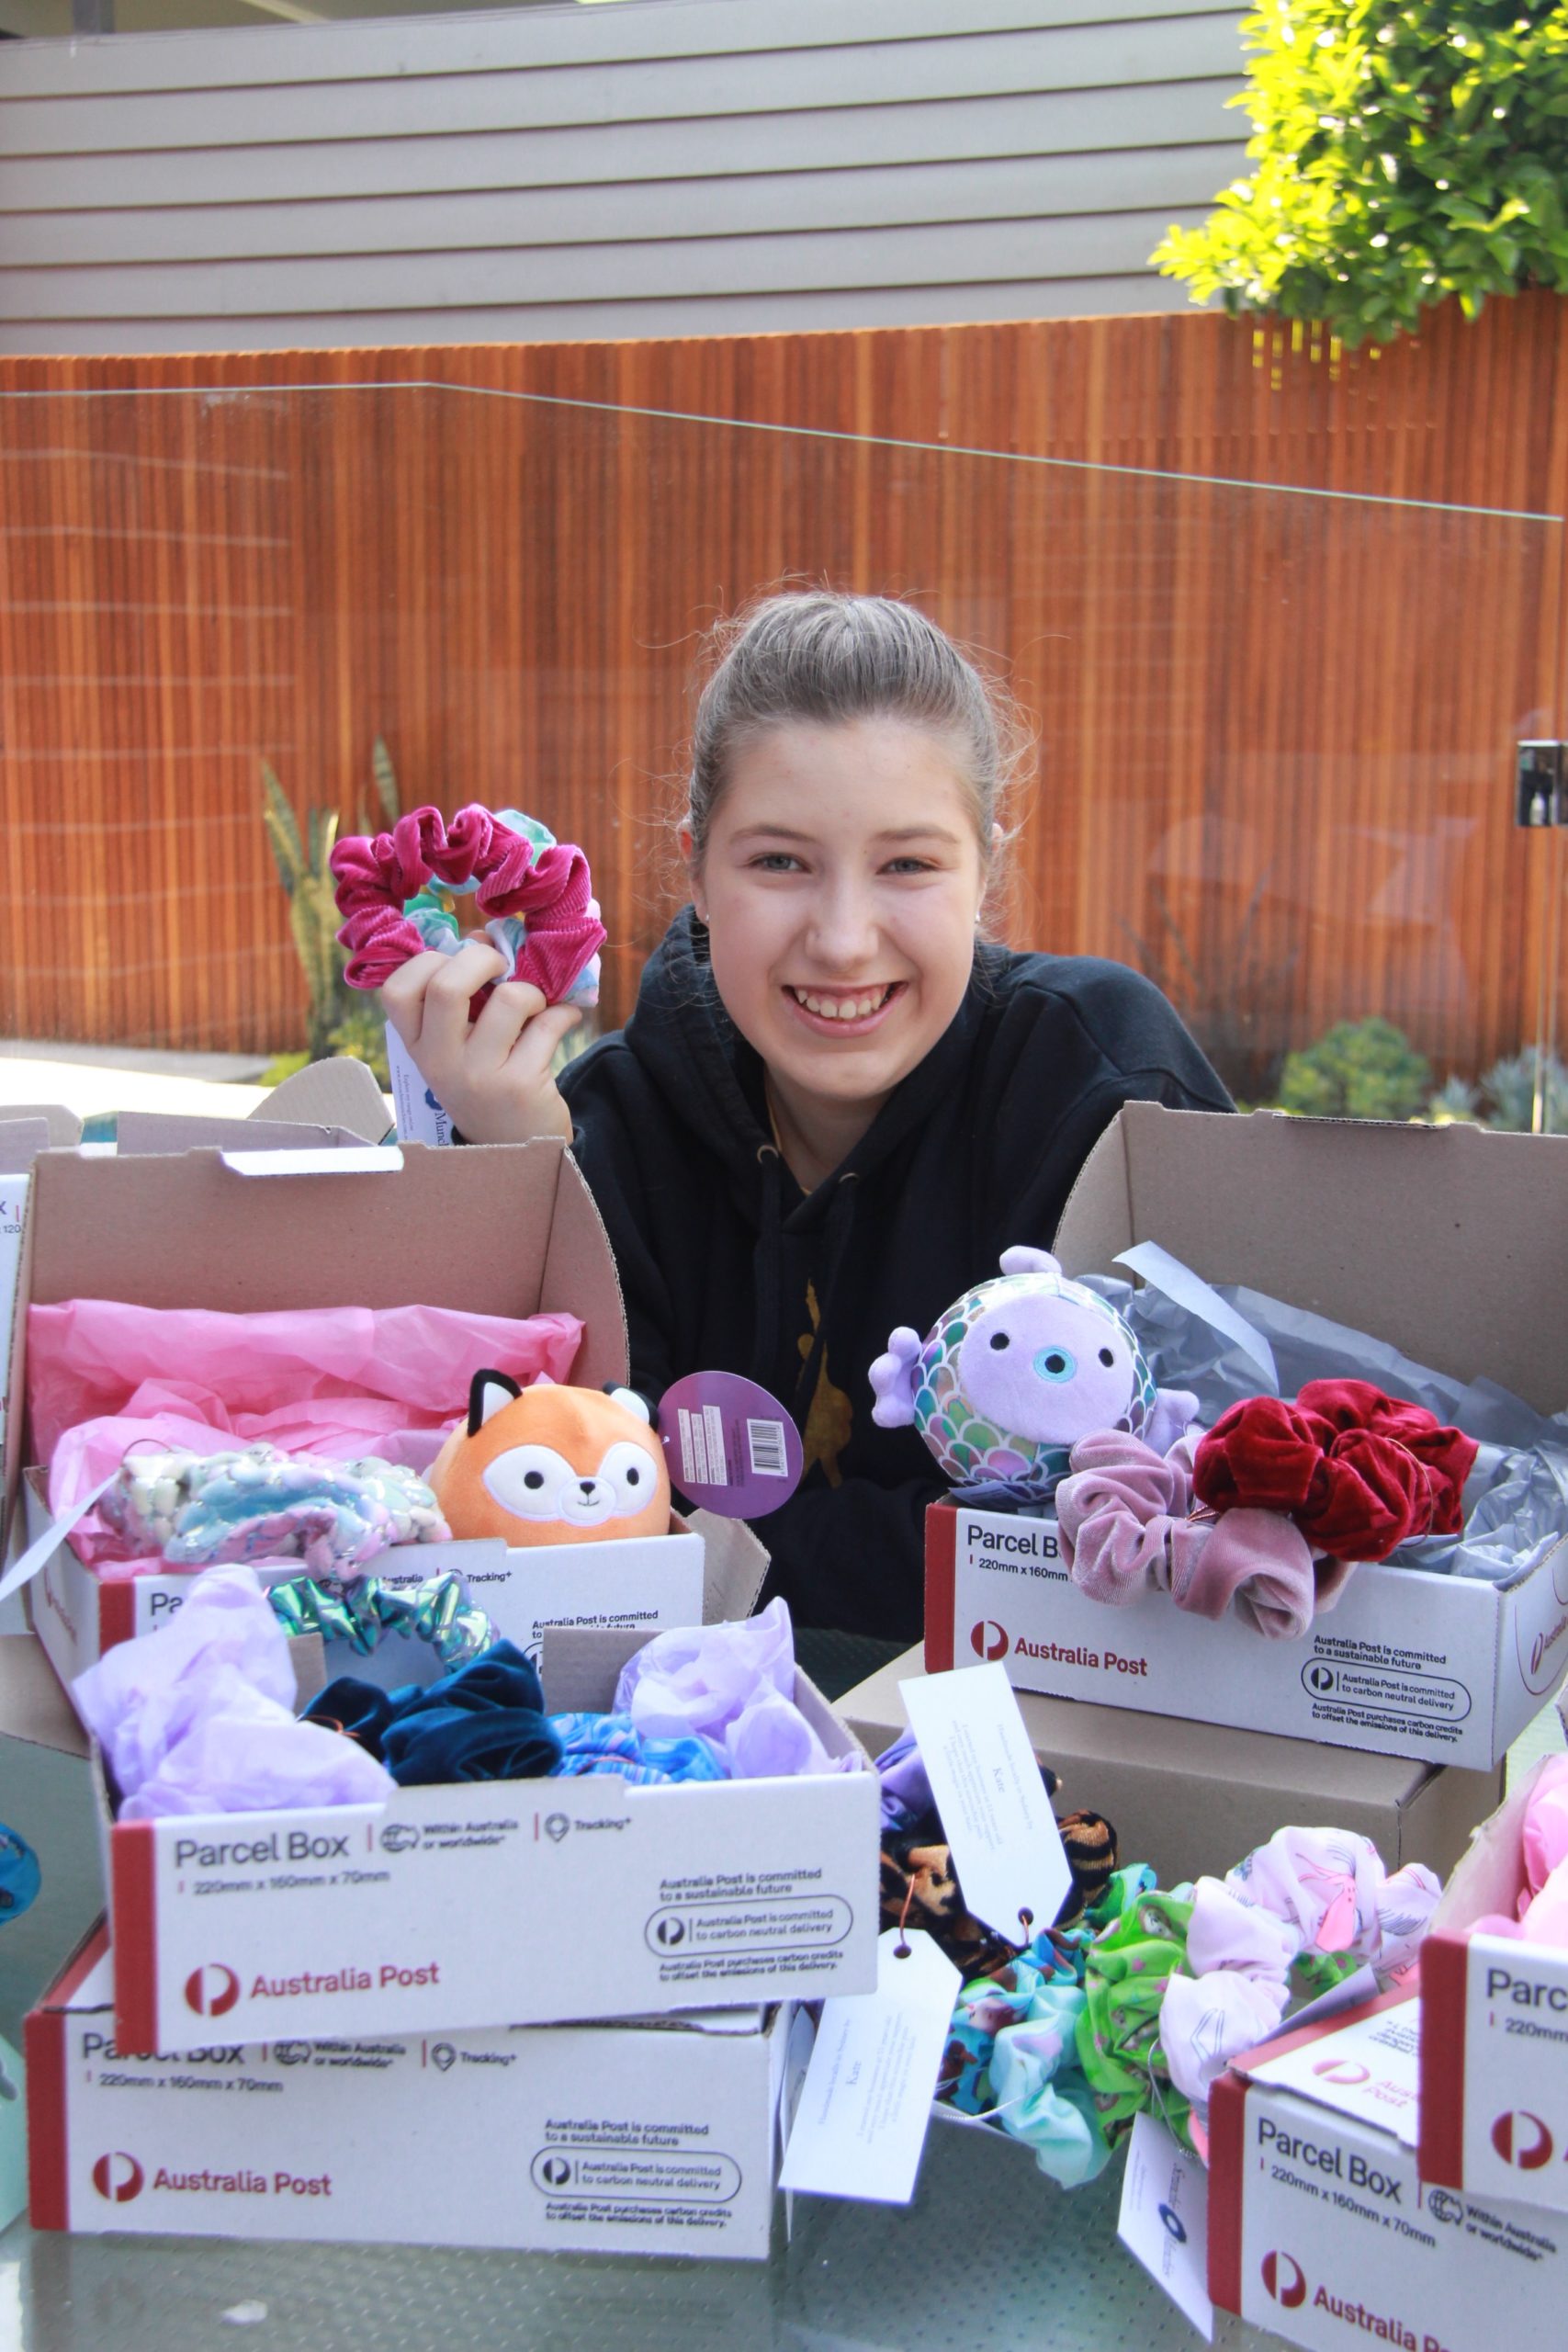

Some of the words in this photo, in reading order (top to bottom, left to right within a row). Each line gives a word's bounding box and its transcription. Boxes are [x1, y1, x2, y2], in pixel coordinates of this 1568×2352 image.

[968, 1524, 1038, 1555] Parcel
[979, 1558, 1018, 1573] 220mm
[1021, 1566, 1027, 1575] x
[1030, 1566, 1067, 1581] 160mm
[577, 1616, 597, 1625] Post
[599, 1614, 606, 1623] is
[608, 1611, 658, 1623] committed
[1014, 1637, 1099, 1668] Australia
[1104, 1652, 1147, 1676] Post
[1314, 1634, 1357, 1649] Australia
[1359, 1642, 1381, 1653] Post
[1383, 1645, 1391, 1655] is
[1393, 1647, 1446, 1665] committed
[1314, 1645, 1324, 1655] to
[1334, 1648, 1390, 1664] sustainable
[1392, 1657, 1421, 1669] future
[1342, 1674, 1379, 1687] Australia
[1381, 1679, 1400, 1690] Post
[1402, 1682, 1408, 1691] is
[1409, 1684, 1455, 1700] committed
[1342, 1684, 1351, 1692] to
[1353, 1685, 1382, 1698] carbon
[1385, 1690, 1416, 1703] neutral
[1418, 1696, 1453, 1711] delivery
[1312, 1711, 1320, 1719] to
[1322, 1713, 1345, 1723] offset
[1347, 1715, 1359, 1724] the
[1359, 1718, 1397, 1732] emissions
[1399, 1725, 1407, 1734] of
[1409, 1726, 1423, 1736] this
[1425, 1730, 1457, 1743] delivery.
[1313, 1702, 1346, 1715] Australia
[1348, 1709, 1365, 1719] Post
[1366, 1713, 1405, 1725] purchases
[1407, 1718, 1434, 1730] carbon
[1435, 1723, 1462, 1736] credits
[175, 1832, 279, 1869] Parcel
[288, 1831, 350, 1860] Box
[194, 1878, 253, 1895] 220mm
[256, 1879, 265, 1891] x
[270, 1874, 326, 1890] 160mm
[330, 1874, 337, 1884] x
[342, 1870, 390, 1883] 70mm
[660, 1875, 713, 1890] Australia
[716, 1872, 743, 1885] Post
[746, 1872, 755, 1883] is
[759, 1868, 822, 1883] committed
[660, 1890, 671, 1902] to
[685, 1884, 753, 1899] sustainable
[756, 1883, 792, 1894] future
[696, 1915, 742, 1928] Australia
[744, 1914, 767, 1925] Post
[769, 1913, 778, 1922] is
[779, 1910, 833, 1921] committed
[696, 1930, 707, 1940] to
[710, 1928, 747, 1939] carbon
[749, 1925, 787, 1937] neutral
[790, 1922, 832, 1935] delivery
[660, 1960, 702, 1973] Australia
[704, 1958, 725, 1968] Post
[728, 1955, 774, 1968] purchases
[777, 1952, 808, 1962] carbon
[810, 1950, 843, 1961] credits
[250, 1968, 371, 1999] Australia
[378, 1962, 439, 1988] Post
[1488, 1968, 1568, 2011] Parc
[99, 2073, 154, 2087] 220mm
[157, 2077, 166, 2087] x
[170, 2076, 222, 2090] 160mm
[226, 2079, 233, 2090] x
[238, 2077, 284, 2093] 70mm
[545, 2119, 598, 2131] Australia
[602, 2120, 628, 2132] Post
[631, 2121, 641, 2132] is
[644, 2122, 708, 2135] committed
[545, 2132, 558, 2142] to
[570, 2132, 638, 2144] sustainable
[642, 2134, 679, 2145] future
[582, 2161, 628, 2174] Australia
[630, 2163, 653, 2175] Post
[656, 2164, 664, 2174] is
[665, 2165, 721, 2176] committed
[1258, 2117, 1342, 2178] Parcel
[1349, 2154, 1402, 2204] Box
[153, 2167, 266, 2193] Australia
[274, 2171, 332, 2196] Post
[582, 2175, 592, 2184] to
[596, 2175, 633, 2185] carbon
[635, 2176, 673, 2187] neutral
[676, 2177, 720, 2190] delivery
[547, 2202, 588, 2212] Australia
[591, 2203, 612, 2212] Post
[614, 2204, 662, 2215] purchases
[664, 2206, 696, 2216] carbon
[698, 2207, 732, 2218] credits
[1271, 2165, 1318, 2196] 220mm
[1322, 2188, 1329, 2201] x
[1332, 2191, 1379, 2223] 160mm
[1382, 2215, 1391, 2227] x
[1393, 2216, 1436, 2247] 70mm
[1467, 2204, 1503, 2230] Within
[1505, 2222, 1556, 2253] Australia
[1314, 2285, 1416, 2352] Australia
